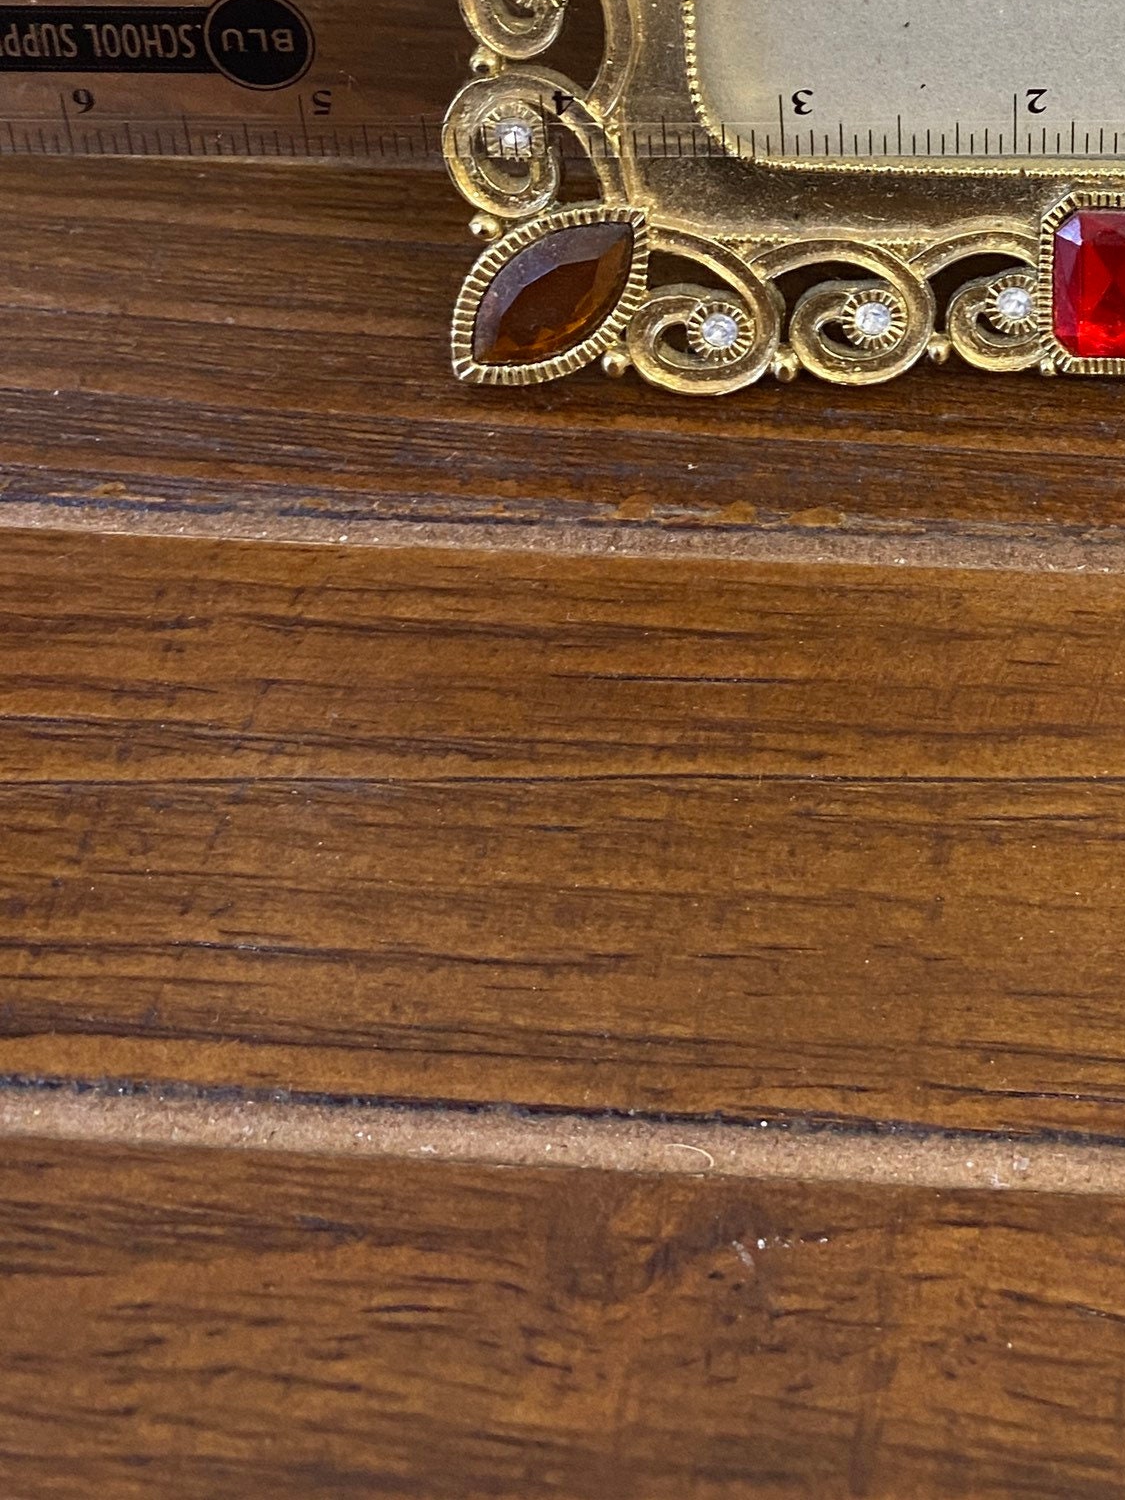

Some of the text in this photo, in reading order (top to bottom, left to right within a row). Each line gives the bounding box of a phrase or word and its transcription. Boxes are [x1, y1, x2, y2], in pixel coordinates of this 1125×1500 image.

[0, 23, 196, 58] SCHOOL SUPP
[221, 27, 294, 53] BLU
[73, 88, 95, 114] 6
[312, 90, 332, 116] 5
[553, 91, 575, 112] 4
[791, 90, 814, 115] 3
[1026, 89, 1047, 113] 2
